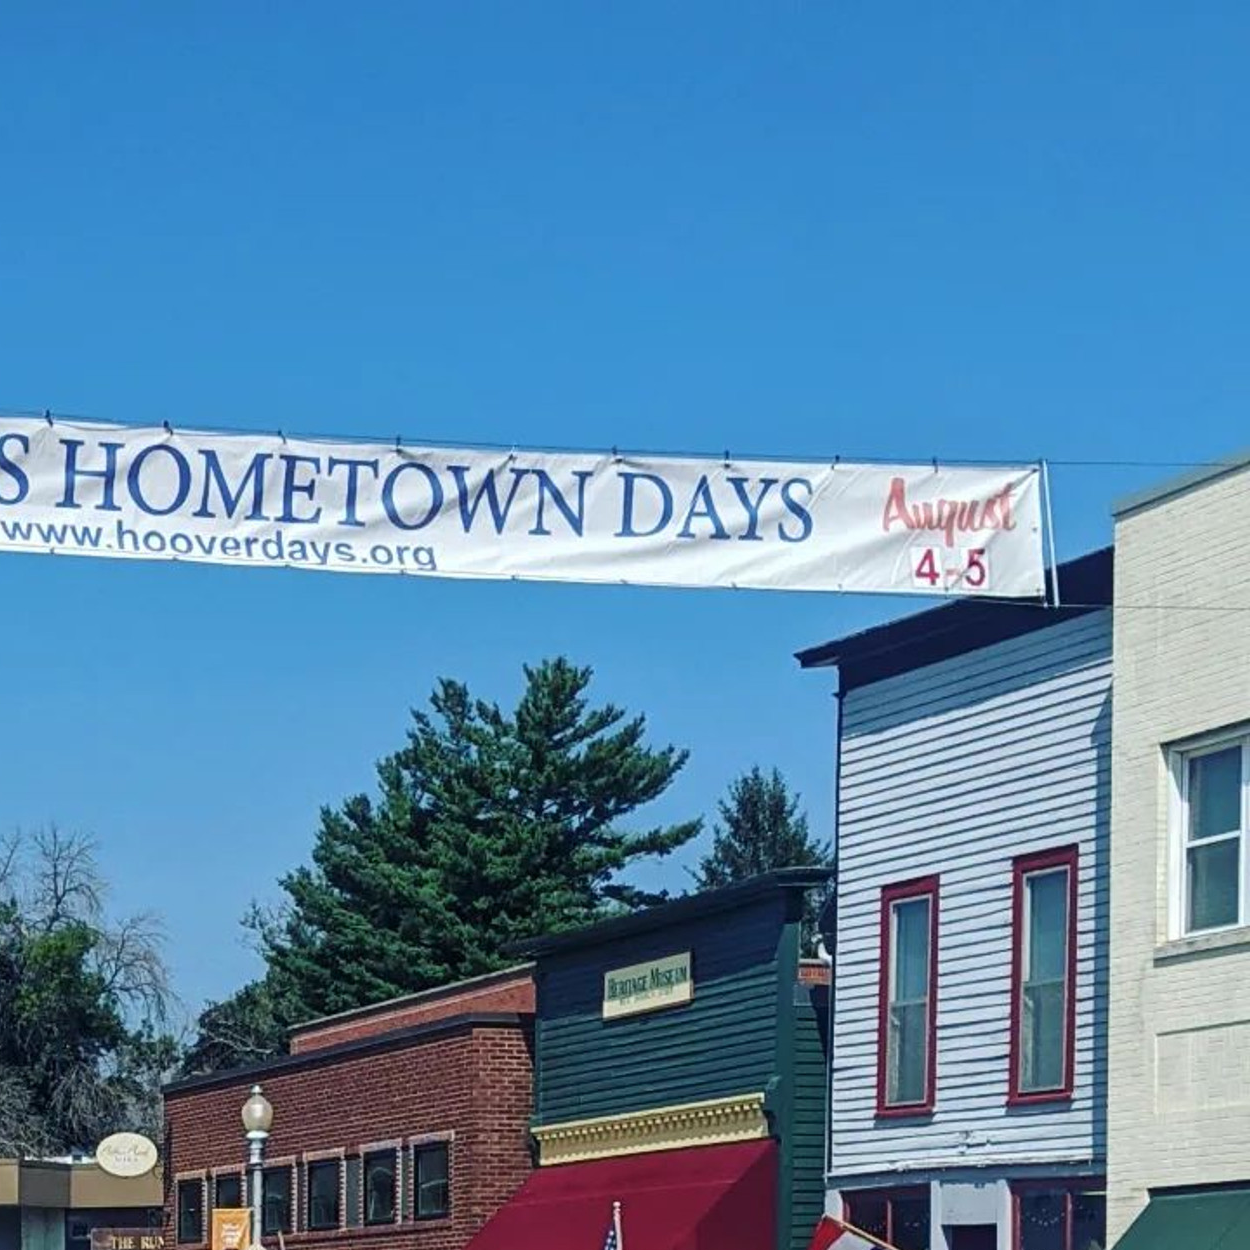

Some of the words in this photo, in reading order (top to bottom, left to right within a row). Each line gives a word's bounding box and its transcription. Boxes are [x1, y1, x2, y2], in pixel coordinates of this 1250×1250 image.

[55, 438, 593, 538] HOMETOWN
[614, 471, 815, 544] DAYS
[881, 476, 1019, 547] August
[0, 519, 438, 571] www.hooverdays.org
[111, 1236, 135, 1250] THE
